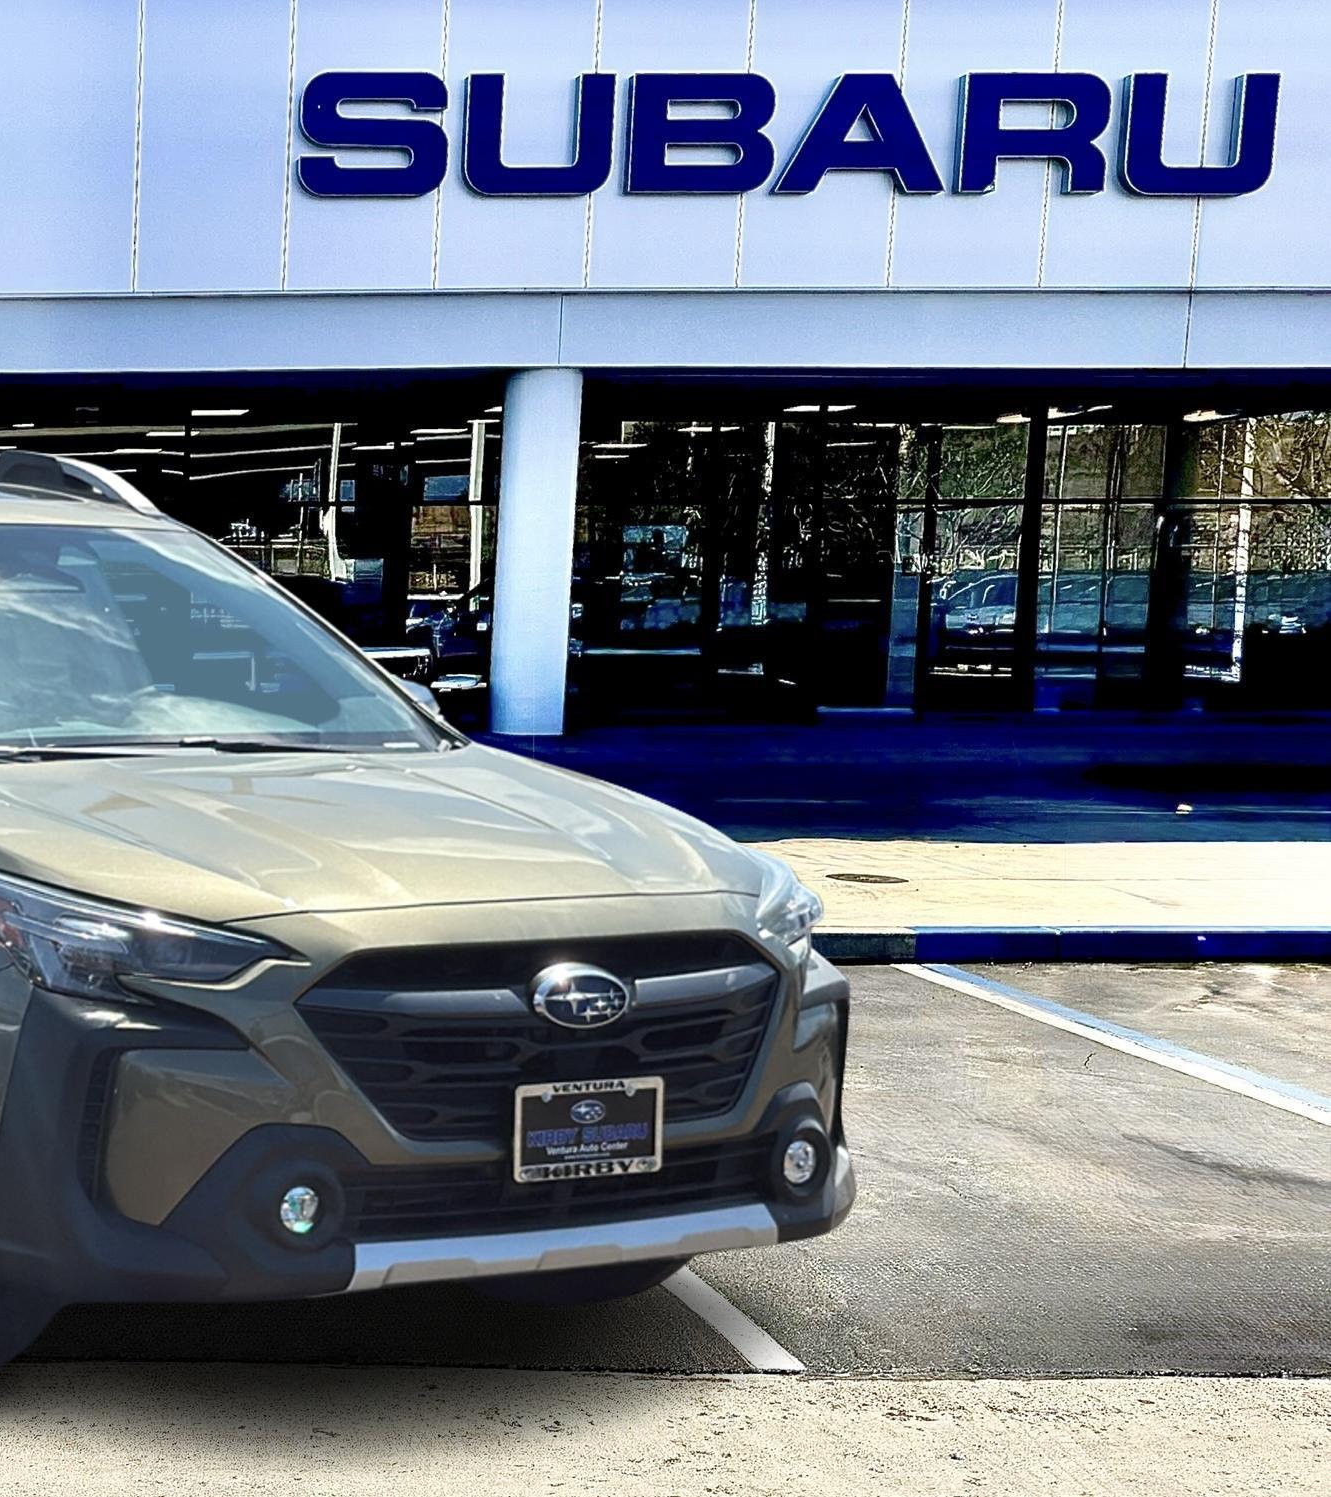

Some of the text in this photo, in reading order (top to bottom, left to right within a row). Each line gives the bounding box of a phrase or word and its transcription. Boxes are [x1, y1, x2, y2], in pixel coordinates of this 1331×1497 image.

[297, 71, 1281, 199] SUBARU
[552, 1080, 626, 1093] VENTURA
[526, 1122, 648, 1148] KIRBY SUBARU
[545, 1145, 578, 1156] Ventura
[579, 1143, 599, 1152] Auto
[600, 1141, 628, 1151] Center
[542, 1160, 633, 1179] KIRBY
